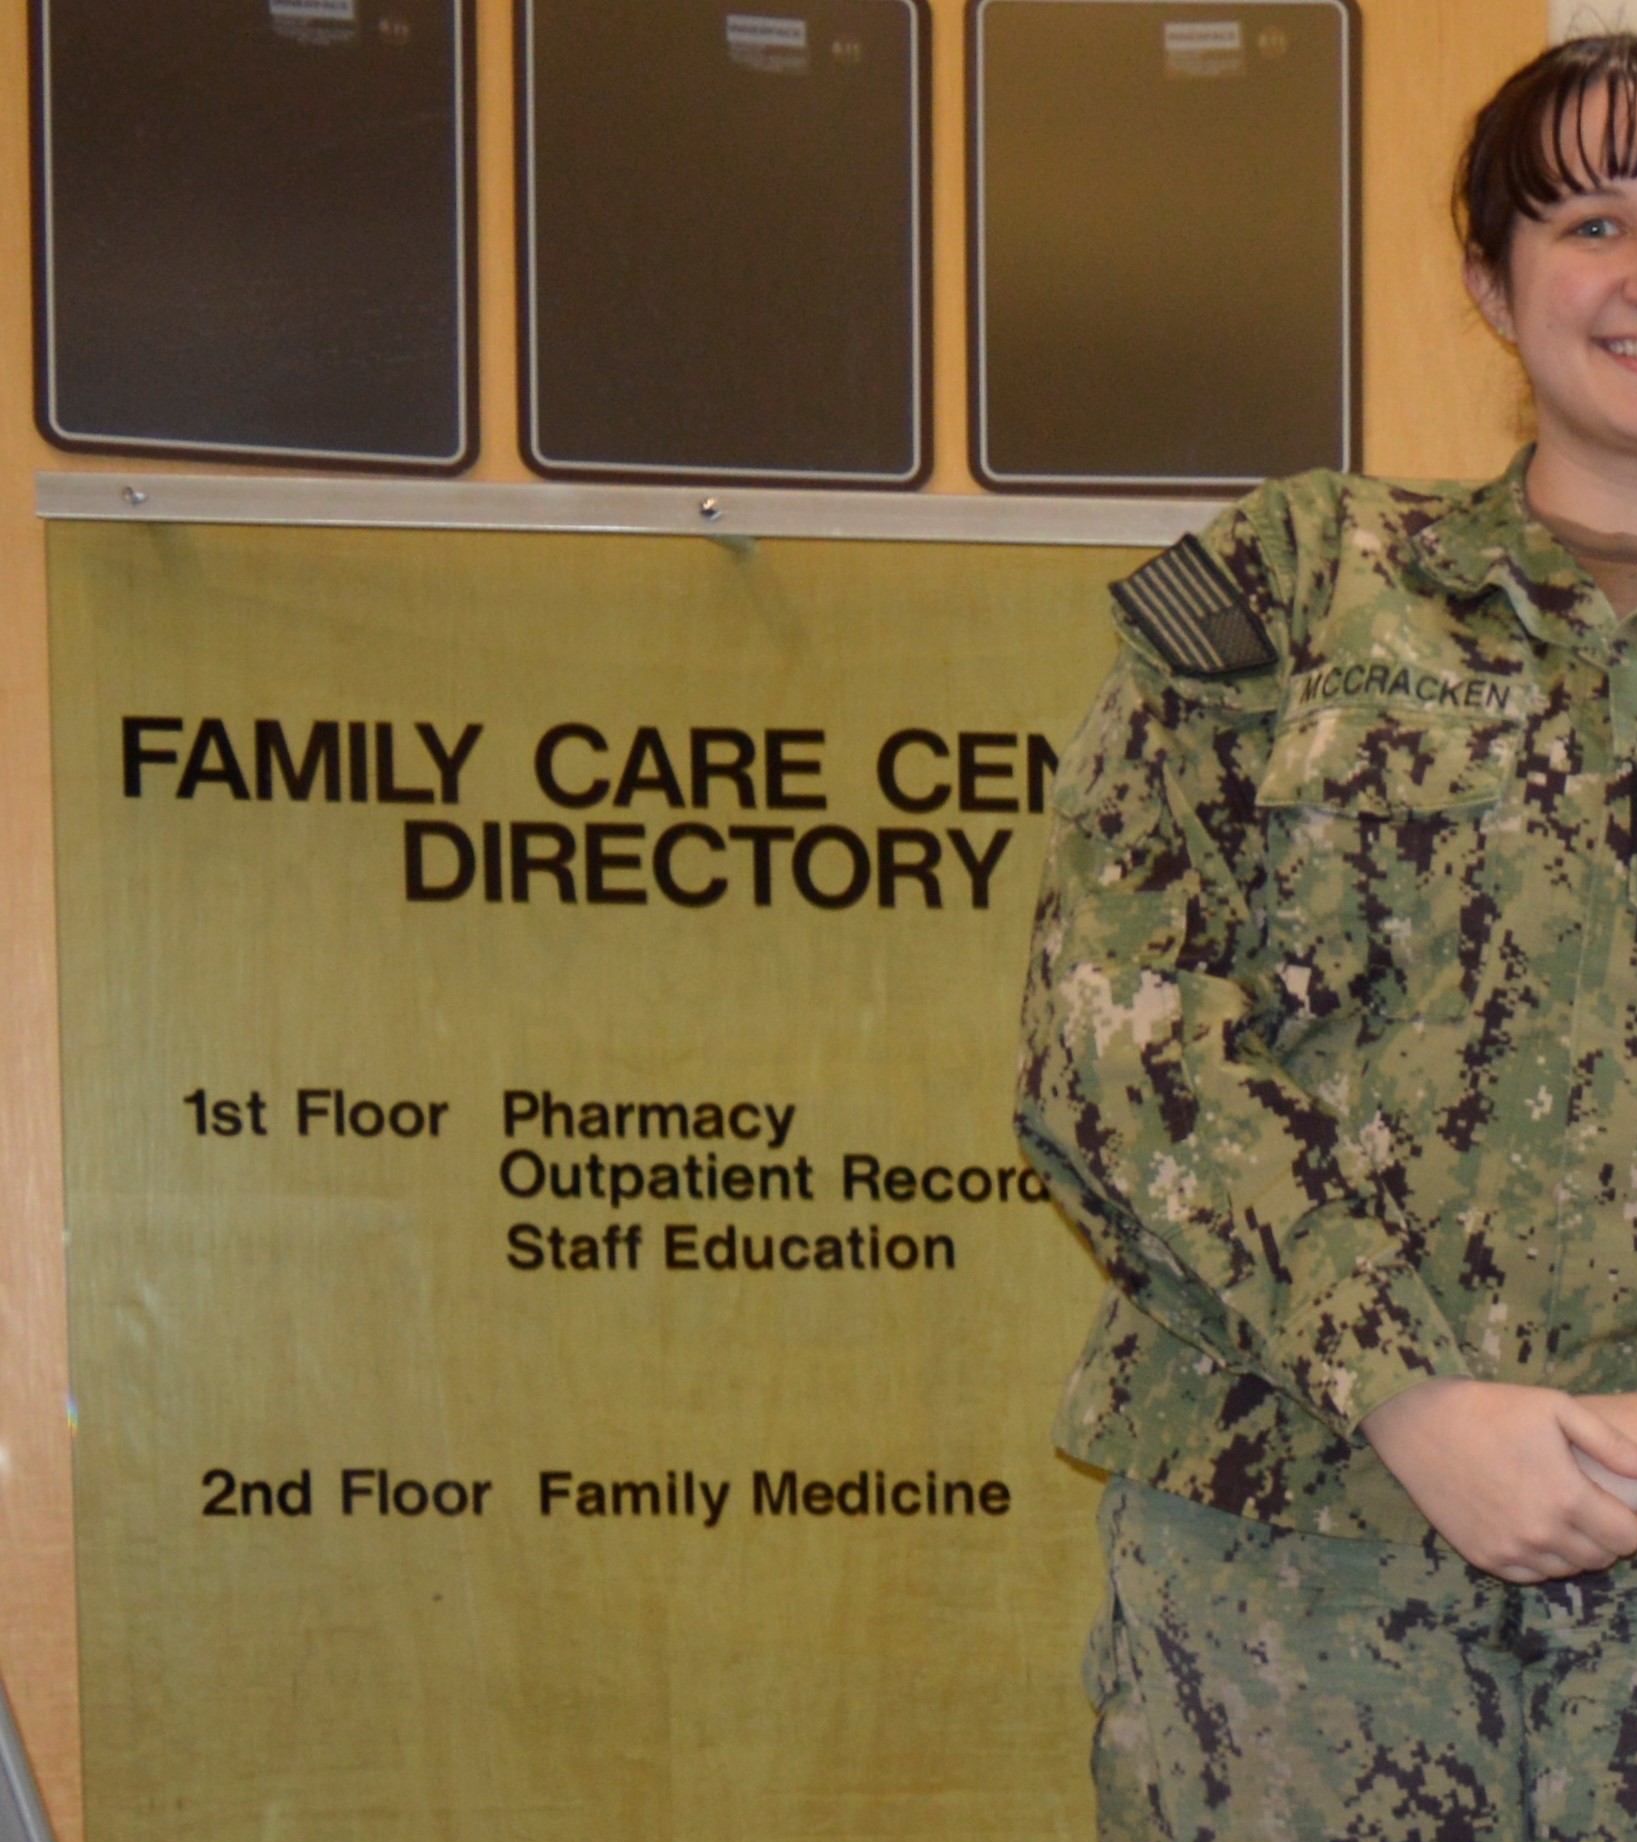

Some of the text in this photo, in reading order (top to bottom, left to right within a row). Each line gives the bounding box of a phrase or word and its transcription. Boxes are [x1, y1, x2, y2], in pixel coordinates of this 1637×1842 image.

[1305, 665, 1508, 710] MCCRACKEN
[123, 717, 482, 804] FAMILY
[535, 723, 827, 809] CARE
[405, 821, 1012, 909] DIRECTORY
[184, 1089, 795, 1149] 1st Floor Pharmacy
[500, 1149, 813, 1208] Outpatient
[508, 1223, 954, 1270] Staff Education
[203, 1469, 1010, 1528] 2nd Floor Family Medicine
